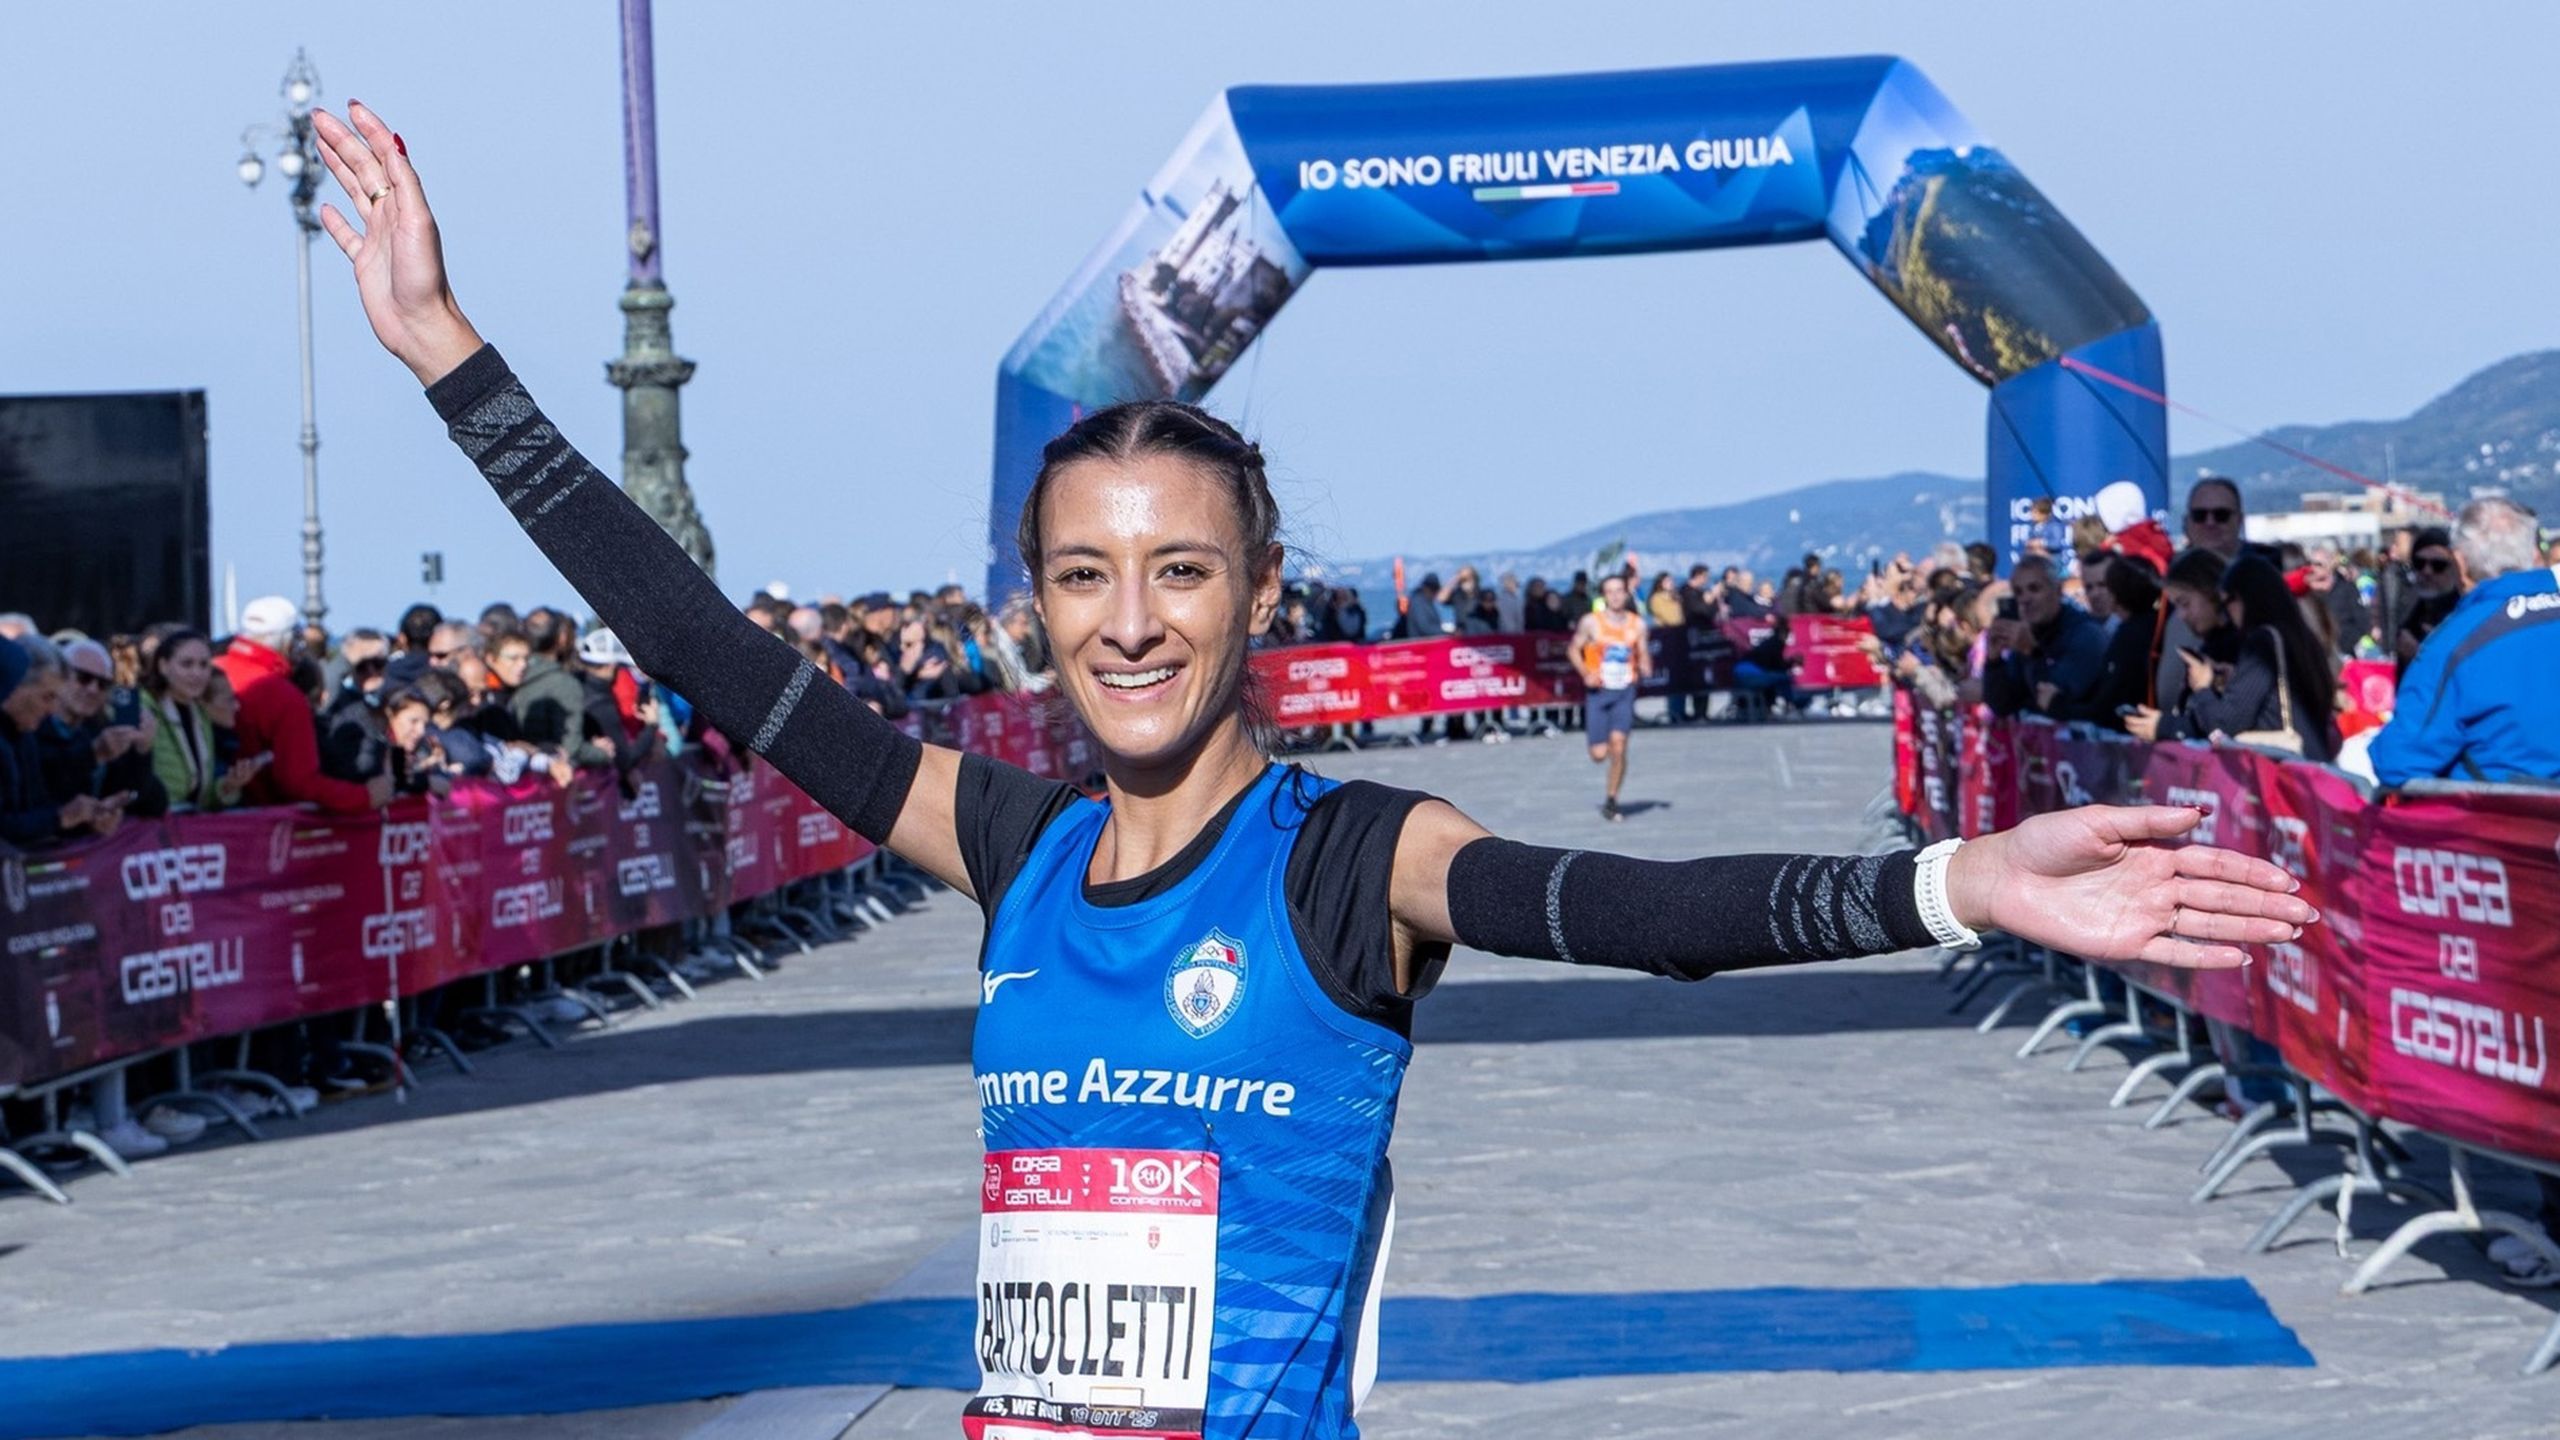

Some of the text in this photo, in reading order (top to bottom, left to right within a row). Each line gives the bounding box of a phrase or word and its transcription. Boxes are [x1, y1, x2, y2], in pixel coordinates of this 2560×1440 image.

[1300, 135, 1794, 190] IO SONO FRIULI VENEZIA GIULIA
[976, 1057, 1296, 1117] mme Azzurre
[981, 1281, 1197, 1380] BATTOCLETTI
[1011, 1397, 1037, 1416] WE
[1048, 1381, 1054, 1398] 1
